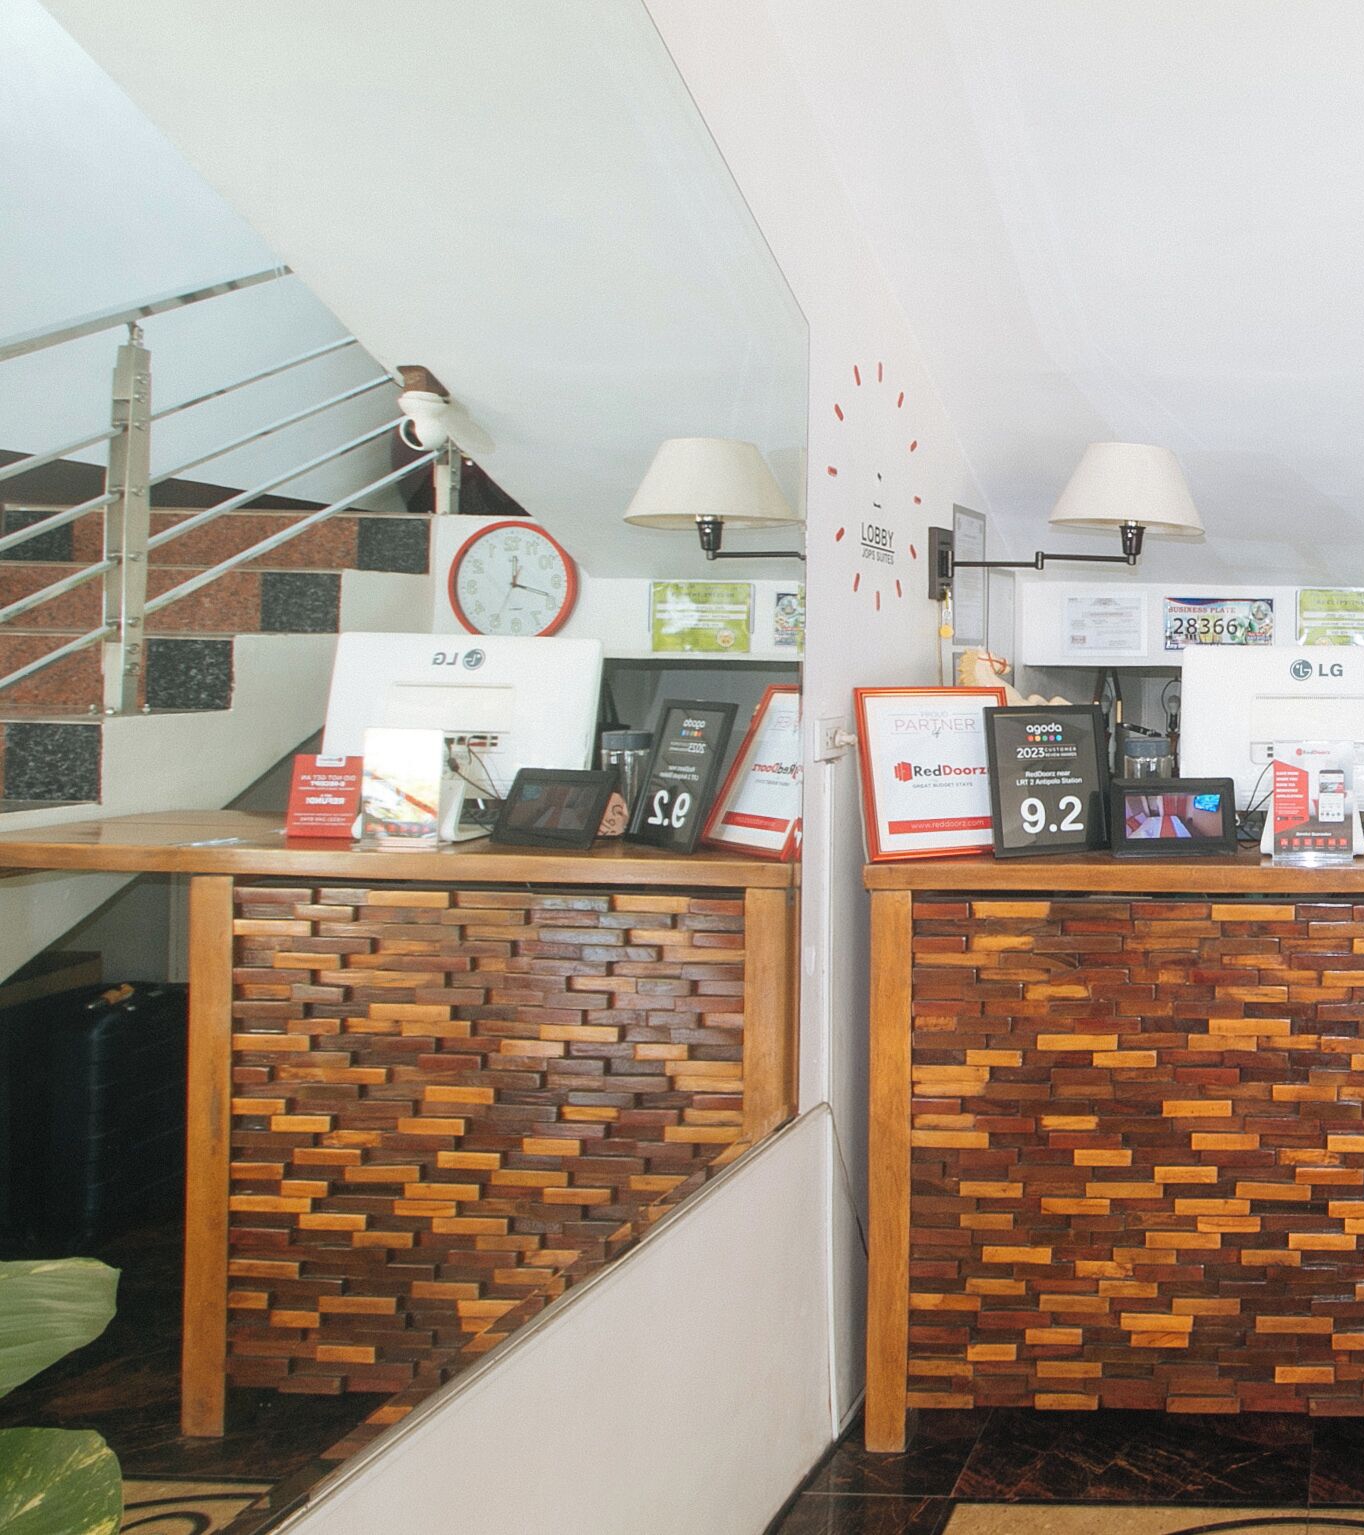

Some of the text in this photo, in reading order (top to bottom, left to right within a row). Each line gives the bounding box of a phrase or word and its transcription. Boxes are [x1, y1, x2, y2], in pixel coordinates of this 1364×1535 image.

[861, 521, 894, 548] LOBBY
[1173, 617, 1238, 635] 28366
[1318, 663, 1343, 677] LG
[894, 718, 976, 731] PARTNER
[1026, 722, 1062, 735] agoda
[1016, 747, 1045, 758] 2023
[913, 764, 987, 777] RedDoorz
[1020, 795, 1084, 834] 9.2
[911, 820, 985, 829] www.reddoorz.com
